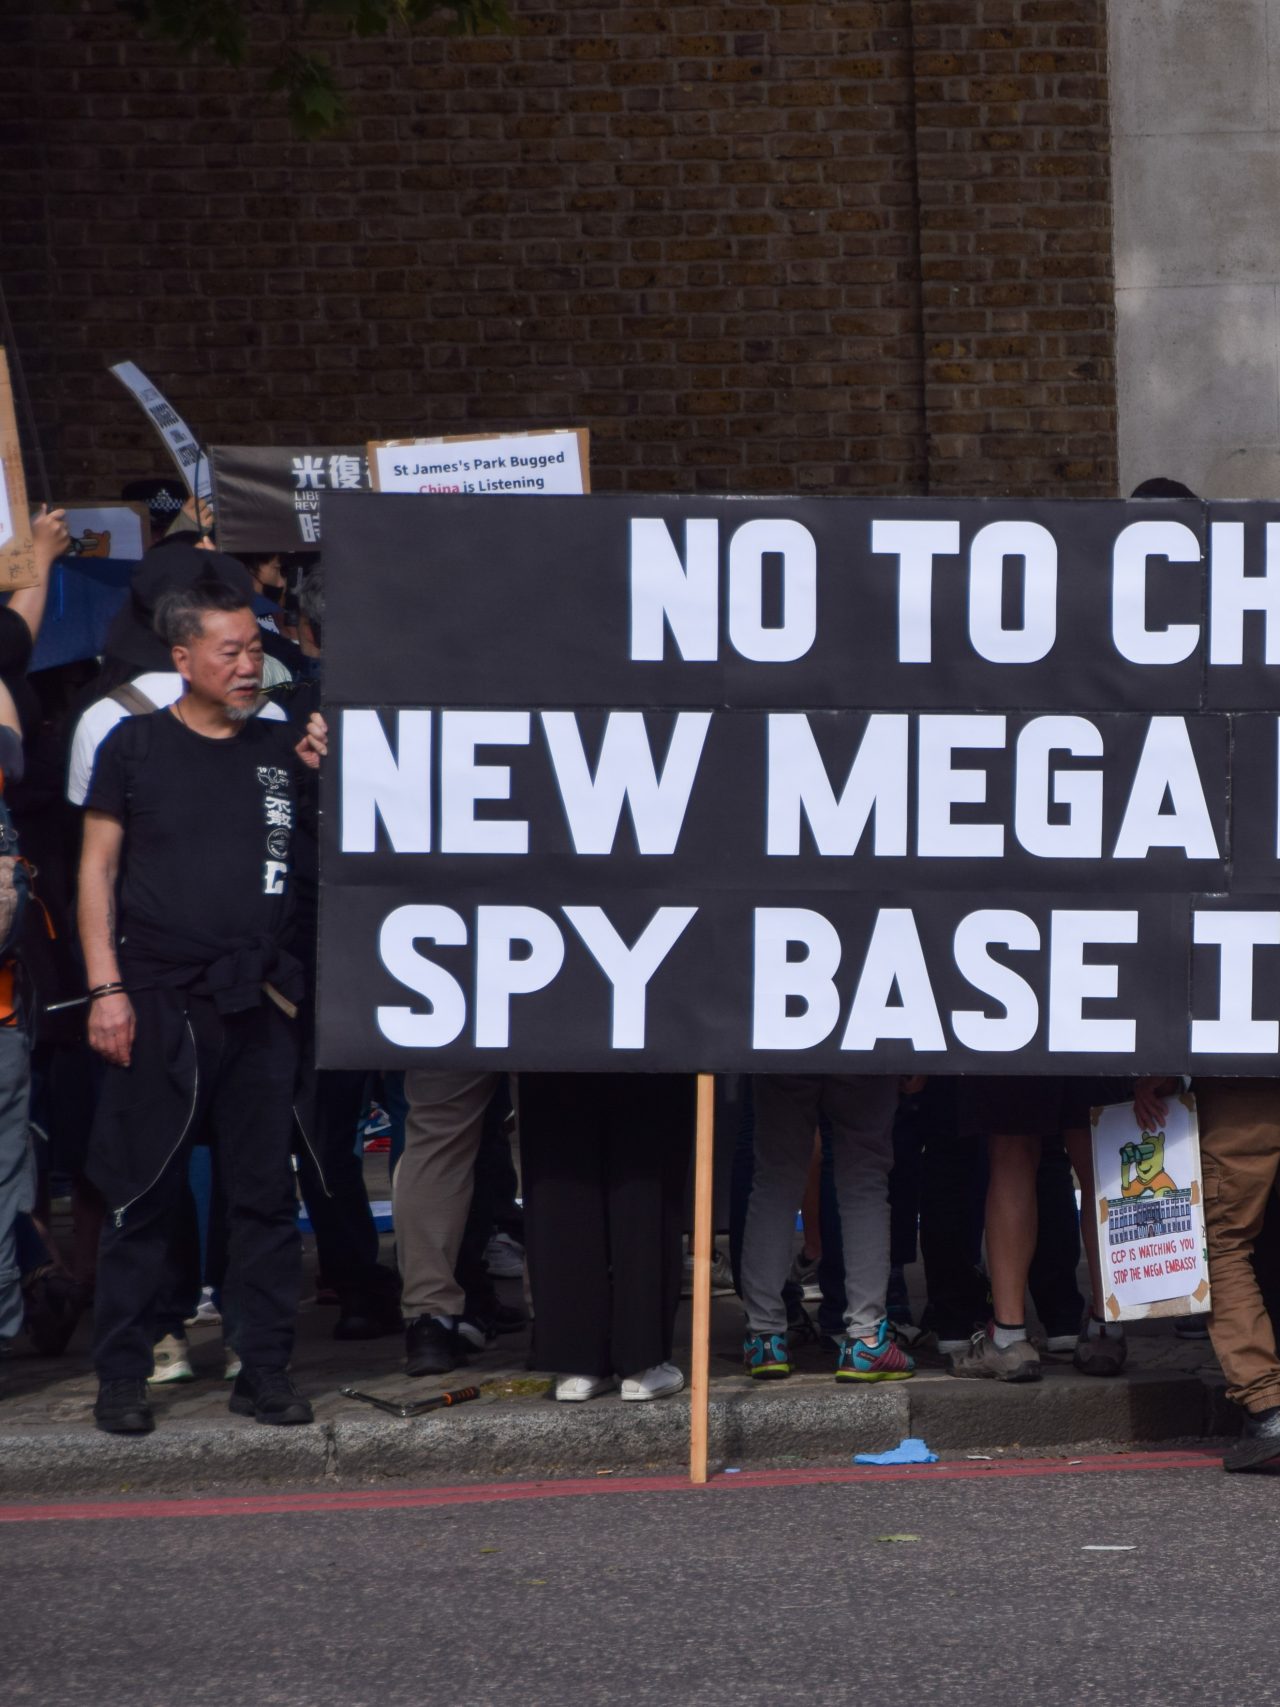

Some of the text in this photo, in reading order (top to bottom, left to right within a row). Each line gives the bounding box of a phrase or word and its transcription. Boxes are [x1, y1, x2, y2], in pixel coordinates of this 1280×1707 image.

[292, 455, 373, 489] 光復
[394, 451, 565, 476] St James's Park Bugged
[419, 476, 545, 494] China is Listening
[630, 517, 817, 663] NO
[871, 519, 1058, 664] TO
[341, 709, 713, 856] NEW
[766, 713, 1221, 860] MEGA
[376, 904, 699, 1049] SPY
[752, 907, 1139, 1053] BASE
[1112, 1238, 1194, 1264] CCP IS WATCHING YOU
[1114, 1256, 1197, 1285] STOP THE MEGA EMBASSY
